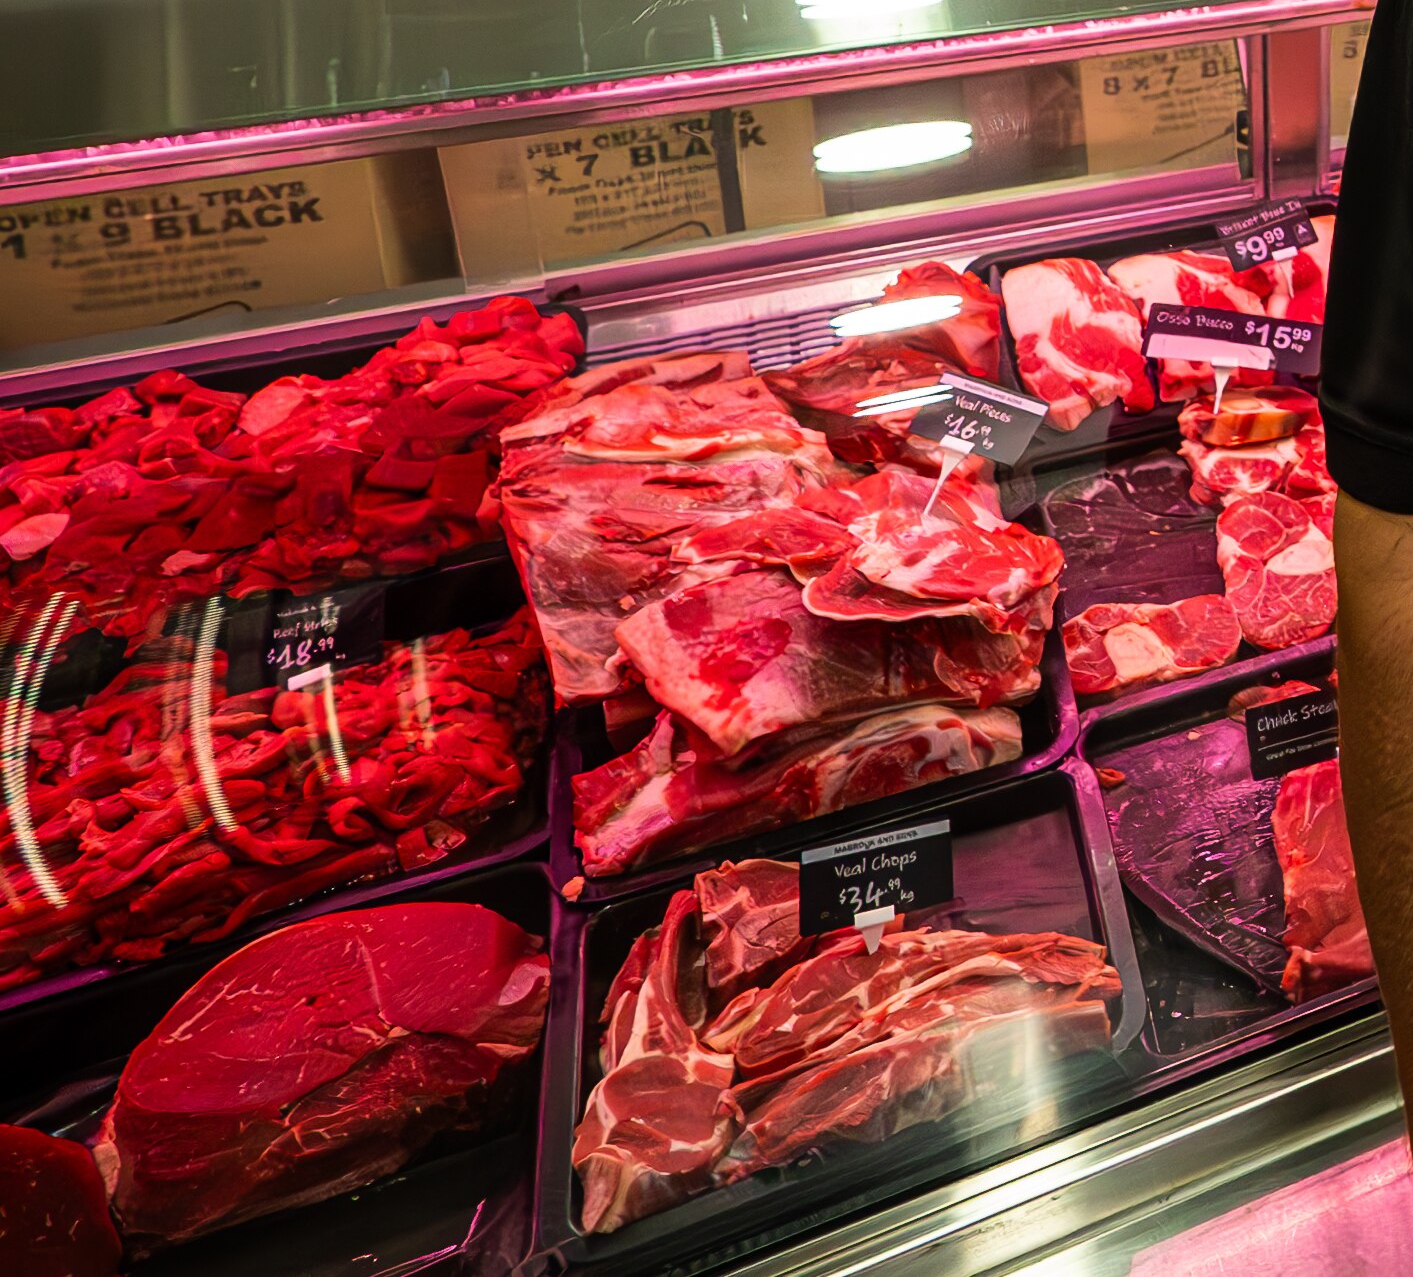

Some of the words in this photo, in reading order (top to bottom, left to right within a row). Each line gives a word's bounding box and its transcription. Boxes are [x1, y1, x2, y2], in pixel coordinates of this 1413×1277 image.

[575, 153, 599, 177] 7
[629, 125, 768, 168] BLAK
[153, 197, 325, 241] BLACK
[834, 857, 867, 878] Veal
[871, 850, 918, 872] Chops
